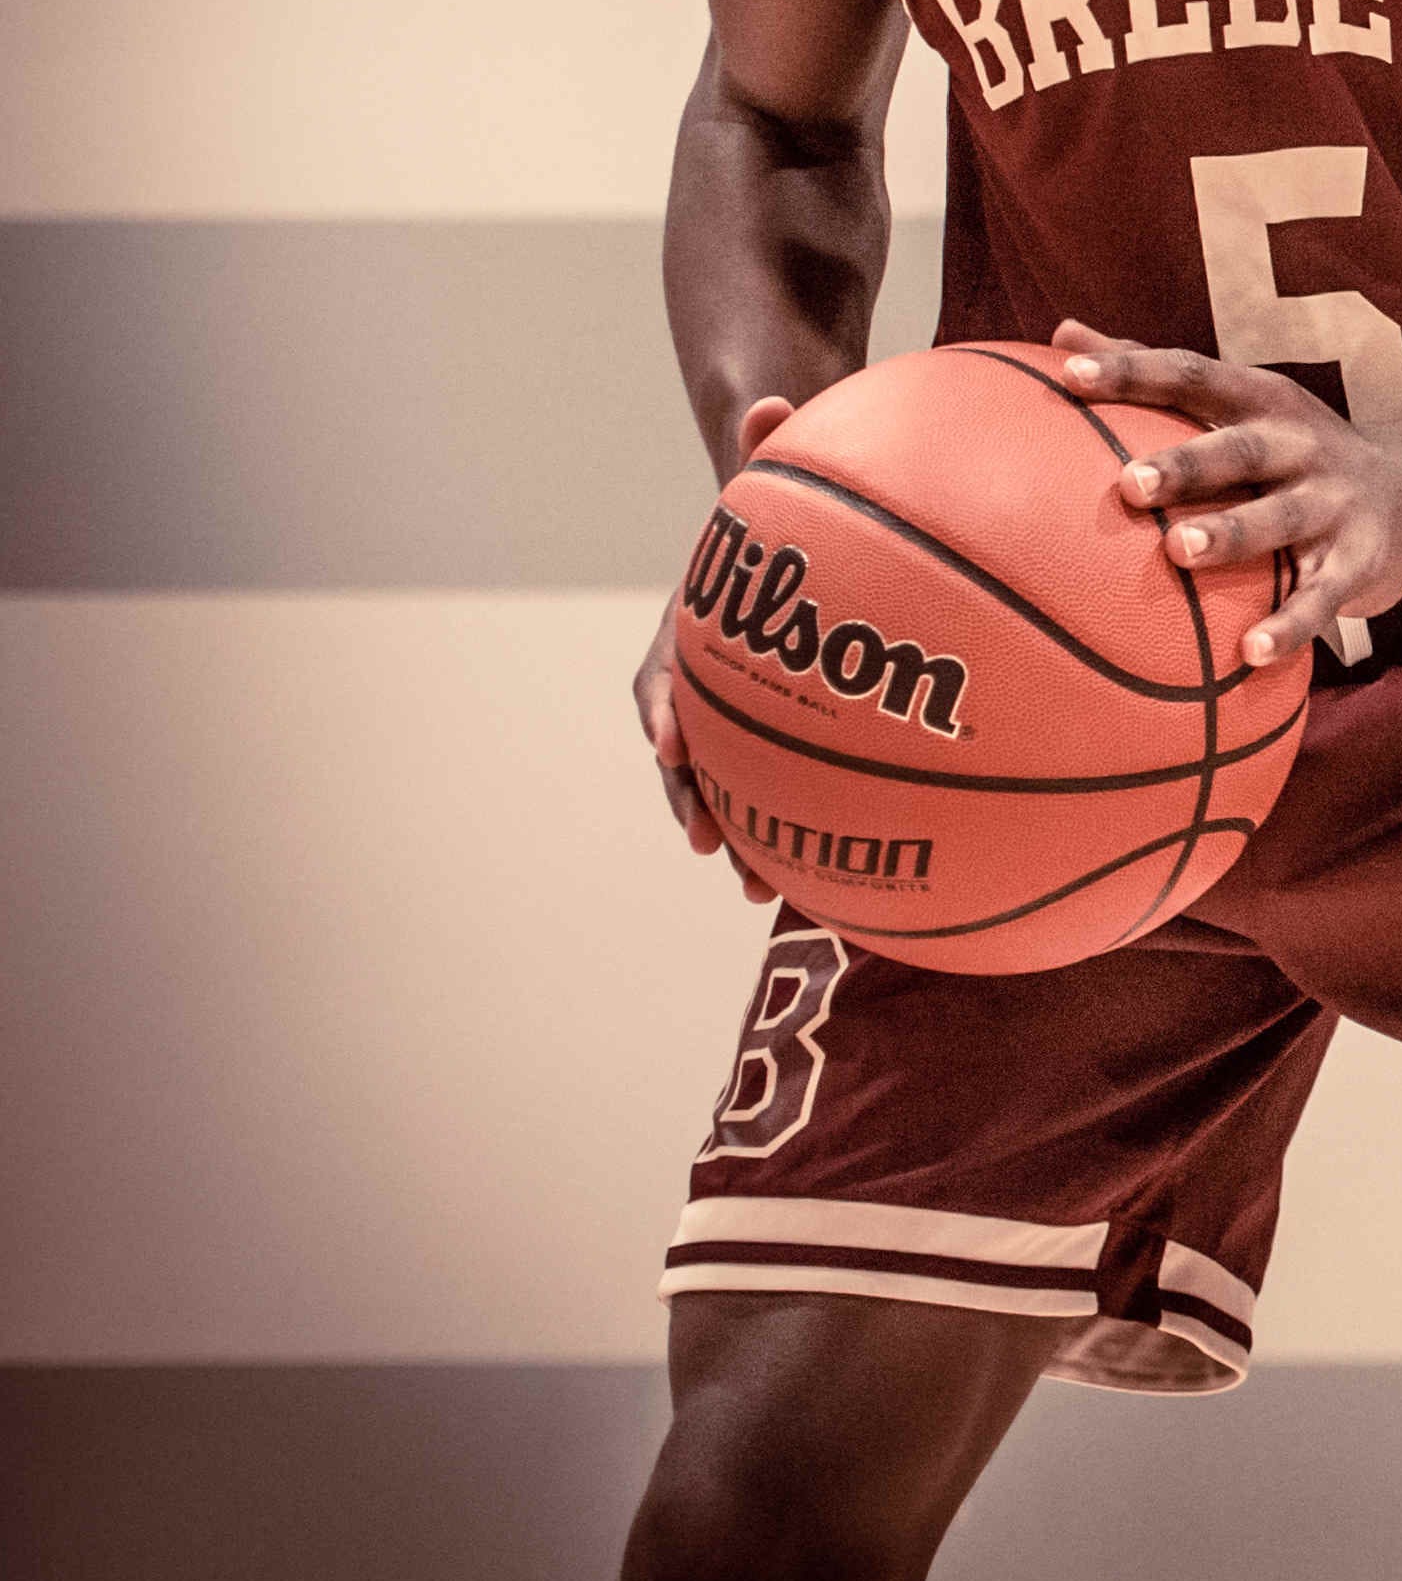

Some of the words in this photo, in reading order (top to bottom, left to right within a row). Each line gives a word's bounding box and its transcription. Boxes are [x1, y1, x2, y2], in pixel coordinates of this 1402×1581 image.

[683, 504, 968, 739] Wilson
[694, 761, 933, 878] OLUTION
[694, 927, 849, 1164] B
